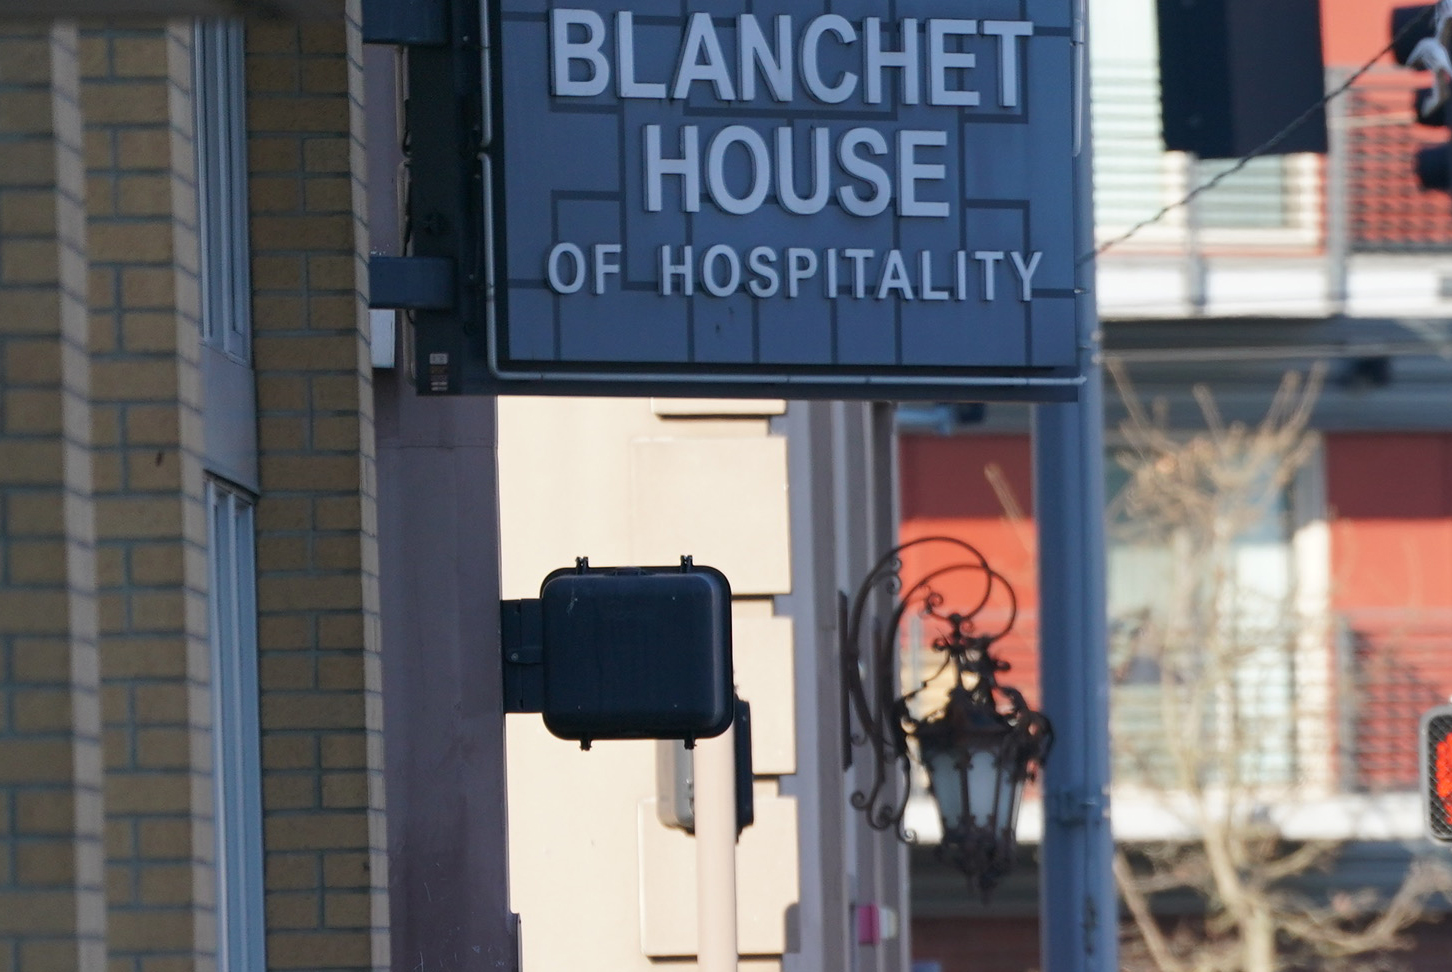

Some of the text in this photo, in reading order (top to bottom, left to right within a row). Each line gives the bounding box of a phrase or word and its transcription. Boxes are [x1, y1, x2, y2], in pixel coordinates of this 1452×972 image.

[549, 8, 1033, 107] BLANCHET
[642, 124, 950, 218] HOUSE
[546, 242, 1042, 302] OF HOSPITALITY
